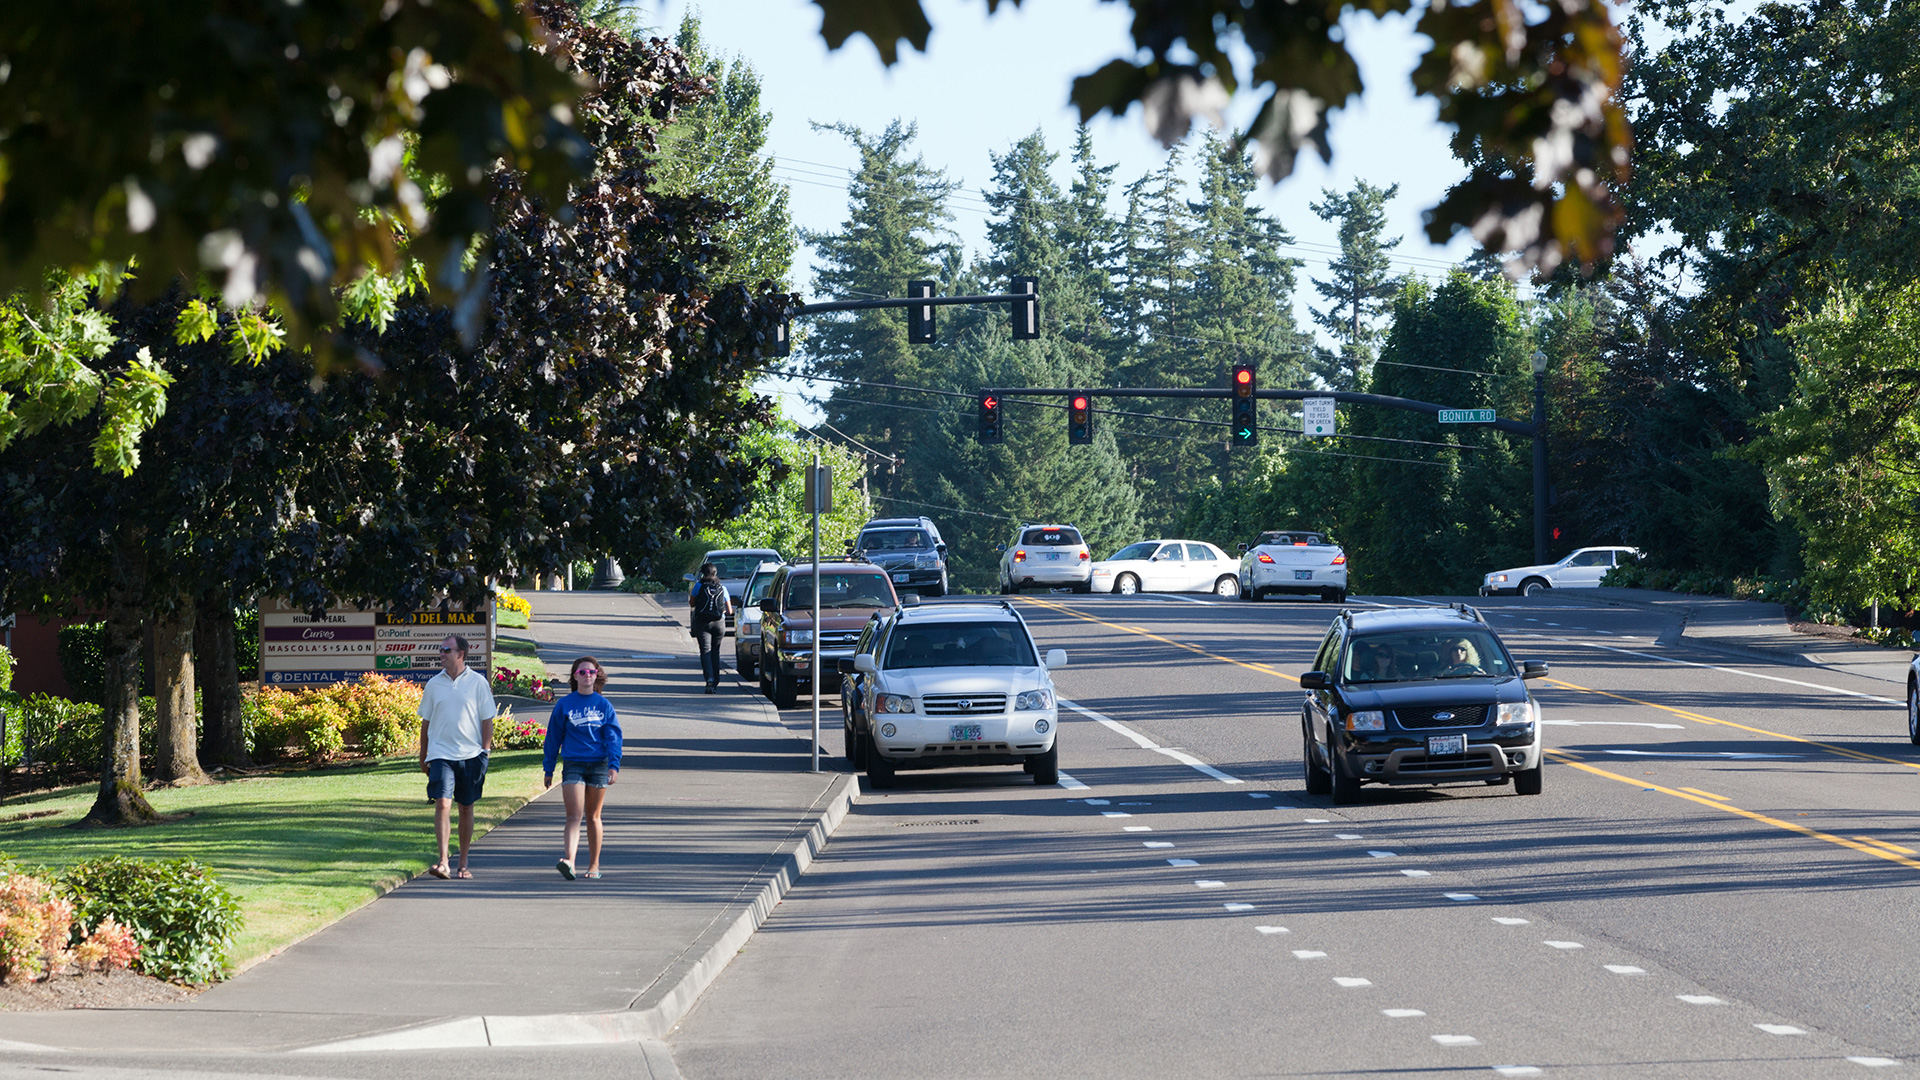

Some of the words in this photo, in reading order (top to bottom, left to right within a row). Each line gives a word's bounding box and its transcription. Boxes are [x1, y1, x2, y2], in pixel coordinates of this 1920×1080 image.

[1442, 412, 1474, 420] BONITA
[1480, 412, 1492, 420] RD
[420, 613, 444, 624] DEL
[448, 613, 476, 624] MAR
[302, 628, 335, 639] Curves
[378, 629, 411, 637] OnPoint
[284, 673, 337, 681] DENTAL
